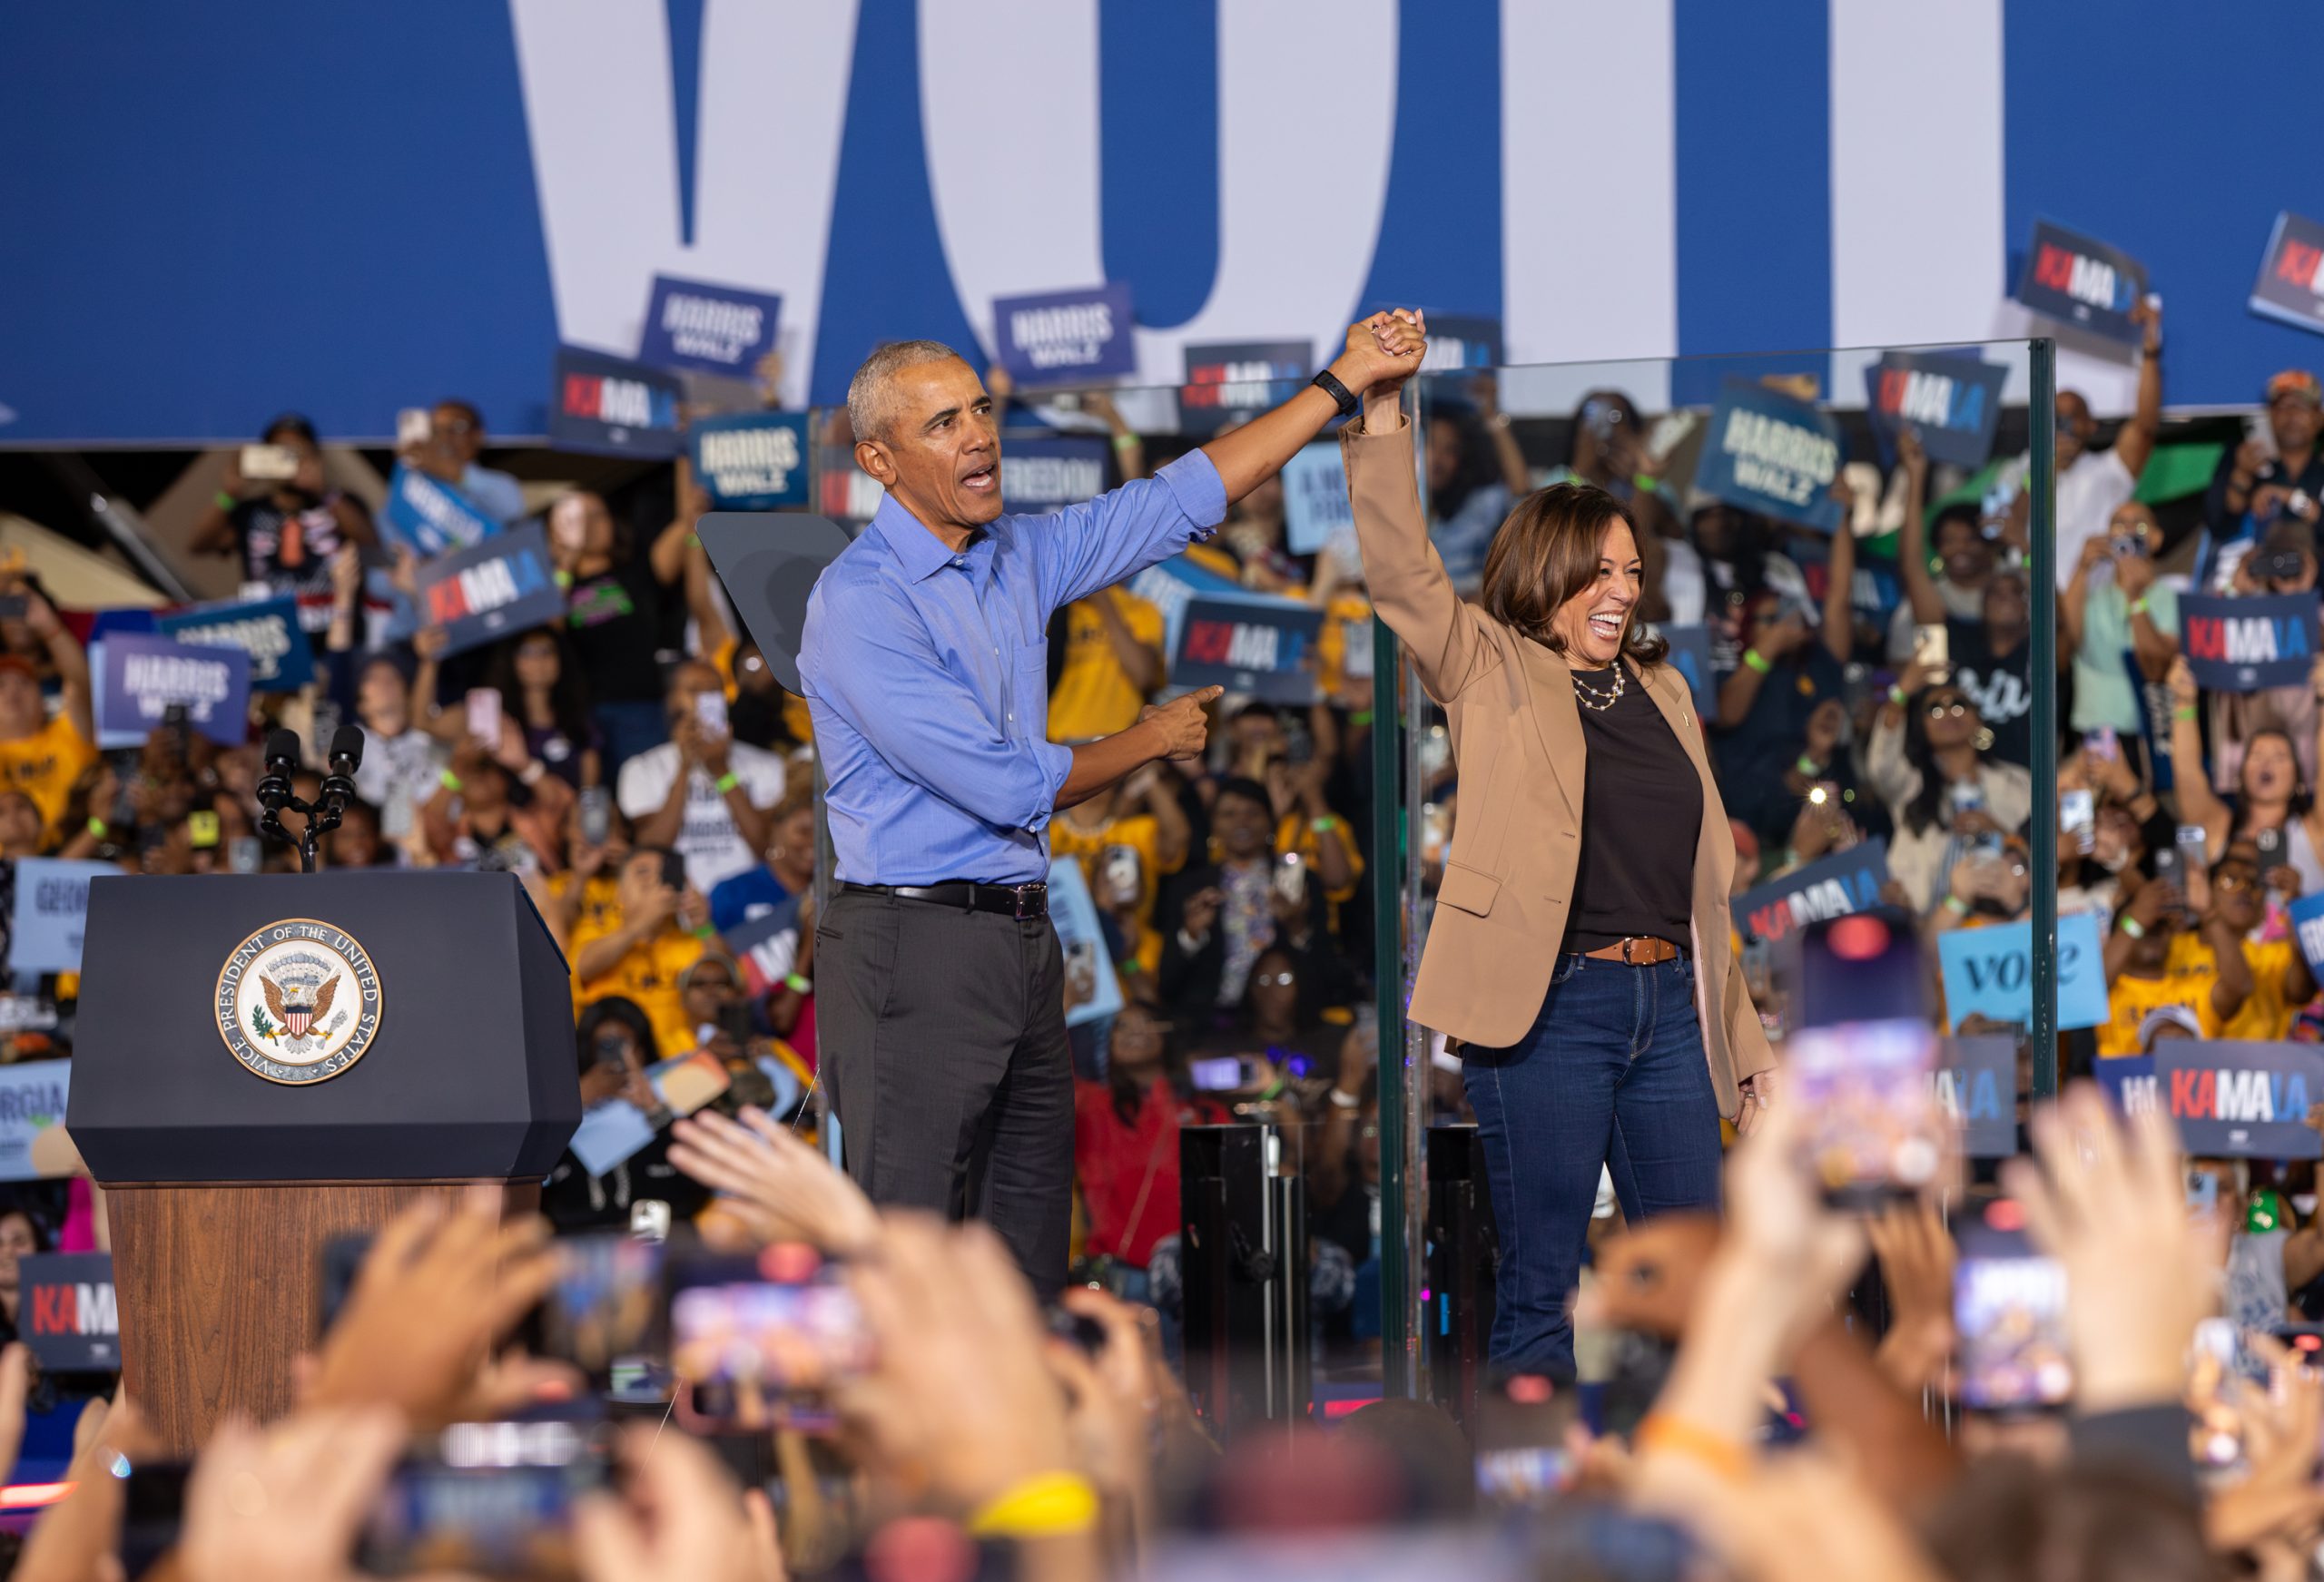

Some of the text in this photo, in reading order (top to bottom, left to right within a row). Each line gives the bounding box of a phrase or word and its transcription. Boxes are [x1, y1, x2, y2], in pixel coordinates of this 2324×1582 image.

[662, 291, 763, 347] HARRIS
[1010, 301, 1114, 352] HARRIS
[672, 329, 746, 365] WALZ
[1029, 339, 1102, 369] WALZ
[699, 425, 800, 475] HARRIS
[1724, 407, 1837, 486] HARRIS
[713, 462, 790, 498] WALZ
[1734, 456, 1814, 506] WALZ
[428, 548, 547, 626] KAMALA
[2189, 614, 2309, 664] KAMALA
[123, 651, 231, 703] HARRIS
[136, 693, 213, 723] WZ
[1748, 866, 1885, 943] KAMALA
[273, 926, 292, 940] OF
[299, 925, 329, 941] THE
[220, 934, 265, 1032] PRESIDENT
[334, 934, 379, 1002] UNITED
[1963, 941, 2082, 994] voe
[232, 1037, 270, 1075] VICE
[325, 1012, 377, 1073] STATES
[2171, 1067, 2310, 1124] KAMALA
